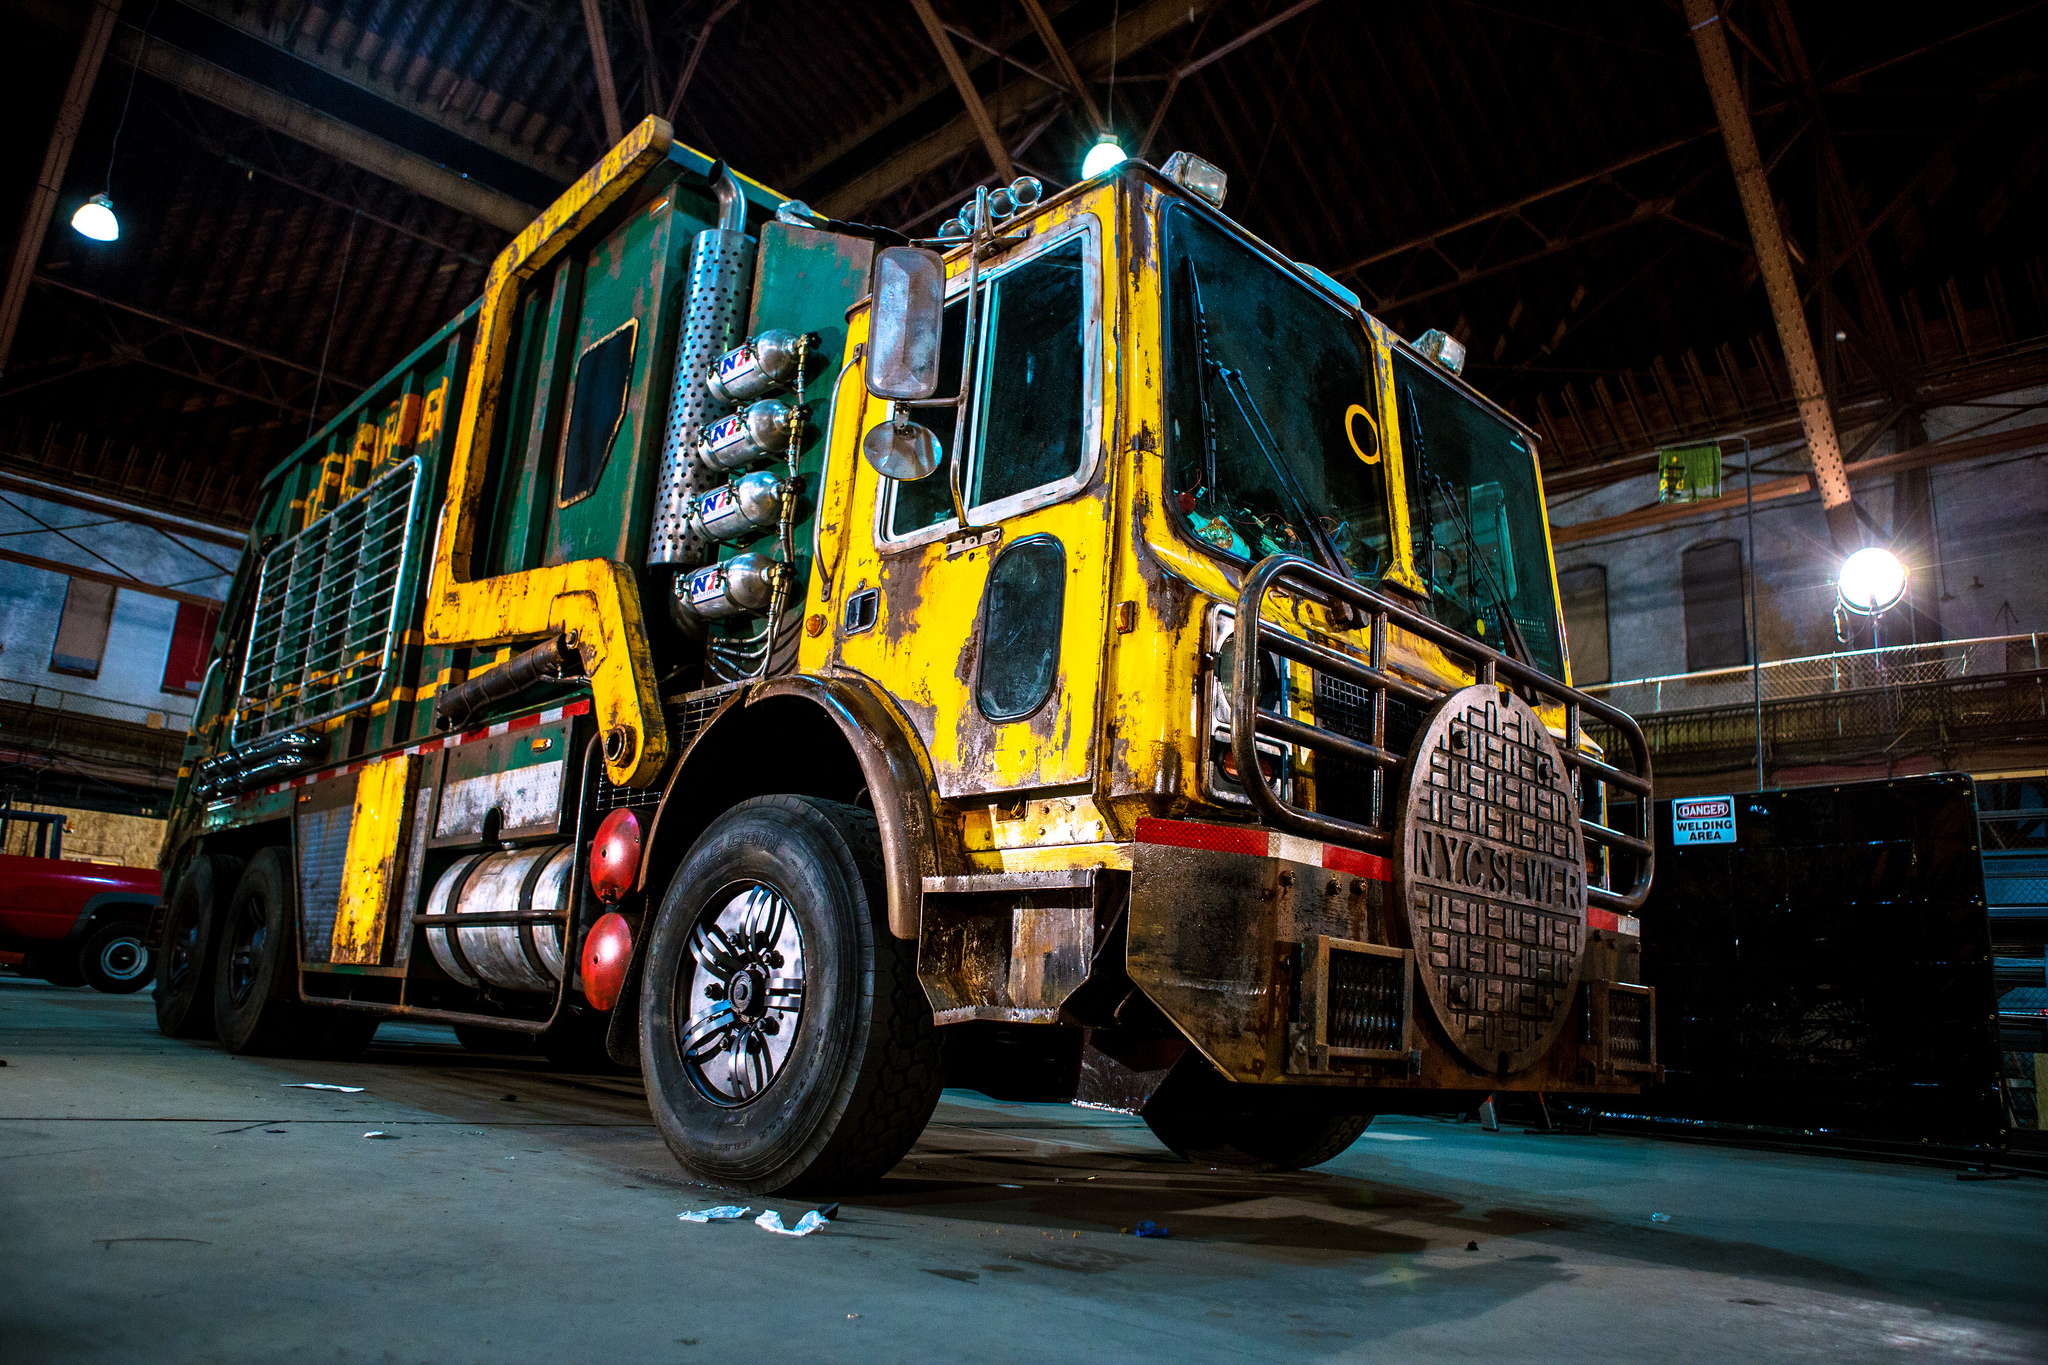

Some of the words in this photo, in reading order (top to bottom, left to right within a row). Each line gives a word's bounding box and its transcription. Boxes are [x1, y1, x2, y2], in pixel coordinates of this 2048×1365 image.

[1681, 804, 1726, 817] DANGER
[1676, 820, 1733, 832] WELDING
[726, 830, 781, 853] COIN
[1688, 831, 1722, 841] AREA
